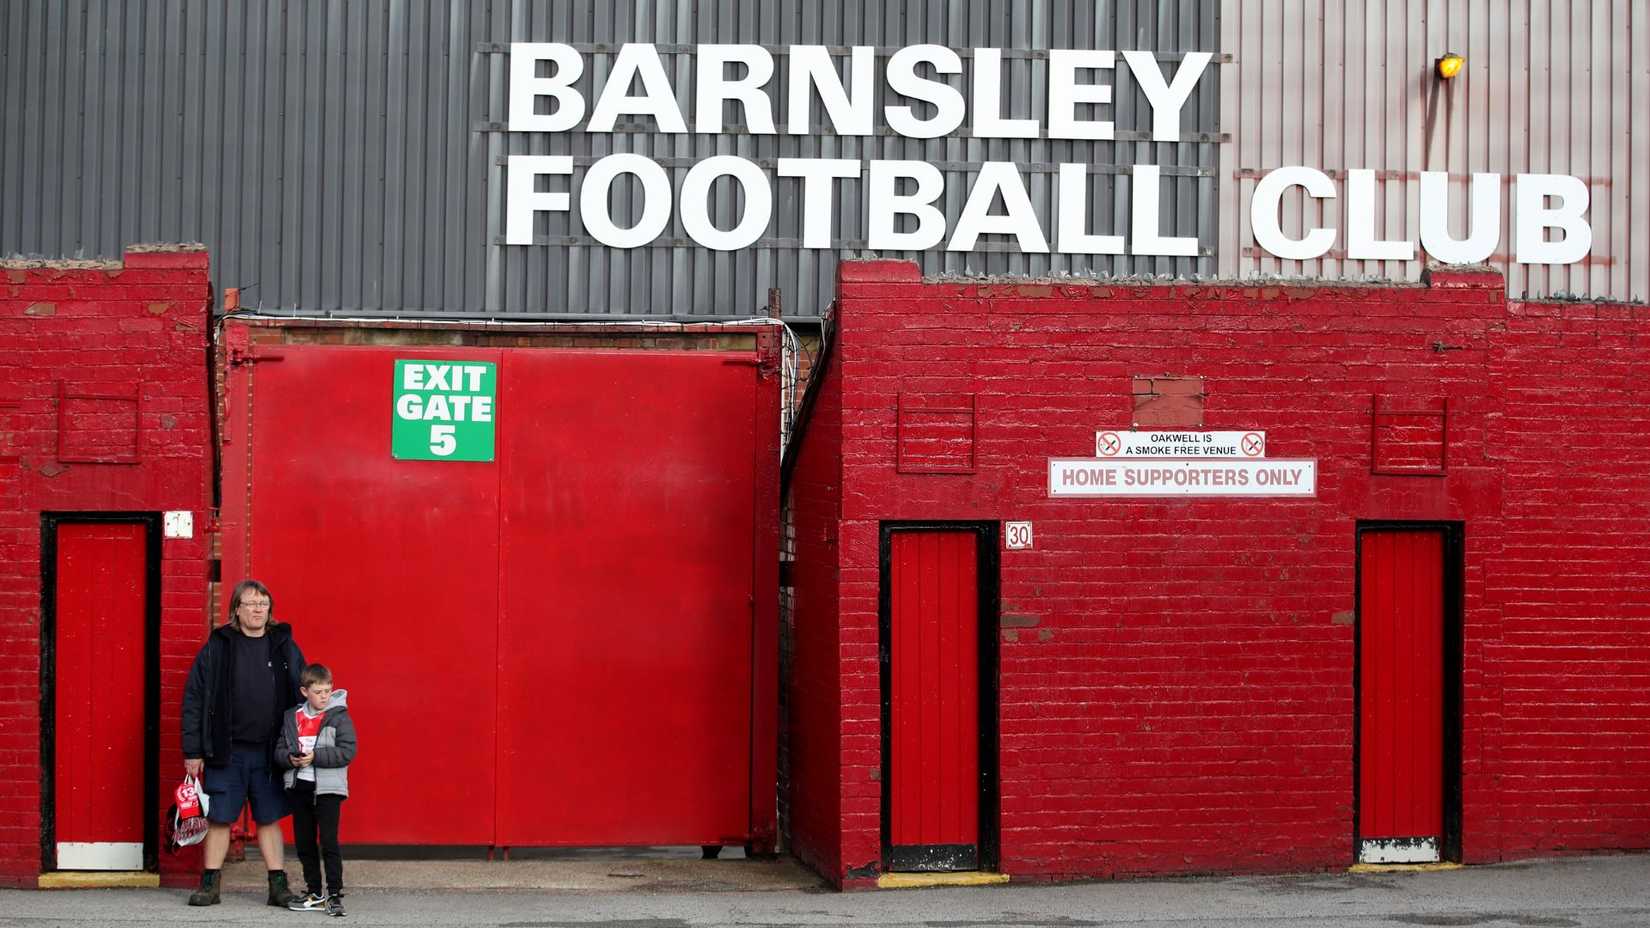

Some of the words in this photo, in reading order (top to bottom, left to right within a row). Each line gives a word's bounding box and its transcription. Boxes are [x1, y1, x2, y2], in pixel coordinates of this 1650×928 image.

[508, 42, 1213, 143] BARNSLEY
[505, 153, 1200, 257] FOOTBALL
[1251, 166, 1592, 264] CLUB
[403, 364, 487, 391] EXIT
[397, 394, 491, 422] GATE
[429, 425, 457, 456] 5
[1126, 446, 1133, 455] A
[1136, 445, 1171, 455] SMOKE
[1174, 446, 1200, 455] FREE
[1202, 446, 1237, 455] VENUE
[1150, 433, 1200, 443] OAKWELL
[1203, 433, 1213, 443] IS
[1062, 469, 1117, 486] HOME
[1124, 468, 1249, 487] SUPPORTERS
[1255, 468, 1303, 486] ONLY
[1010, 526, 1028, 544] 30
